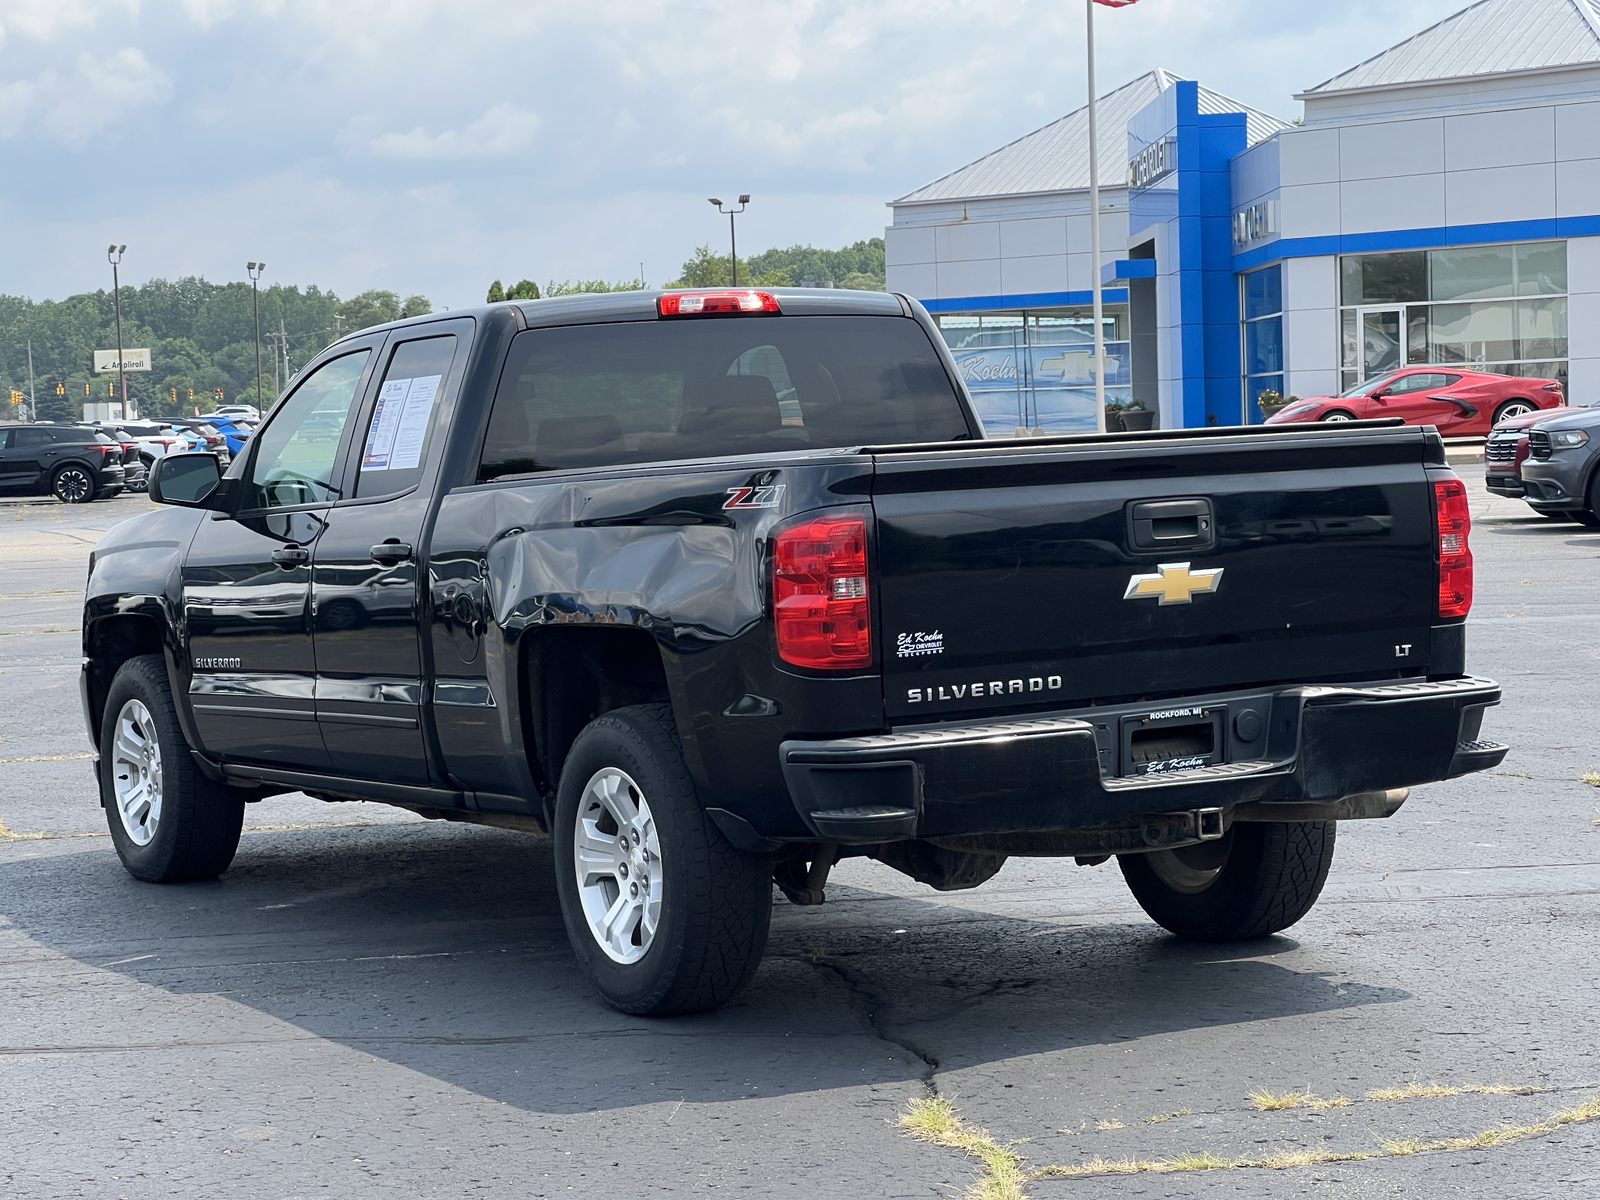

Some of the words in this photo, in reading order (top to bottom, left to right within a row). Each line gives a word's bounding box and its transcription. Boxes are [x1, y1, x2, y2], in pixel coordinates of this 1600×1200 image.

[963, 354, 1022, 382] Koehn
[721, 484, 786, 510] Z71
[897, 632, 913, 645] Ed
[914, 629, 943, 643] Koehn
[915, 641, 943, 649] CHEVROLET
[1395, 644, 1412, 657] LT
[195, 657, 241, 668] SILVERADO
[907, 675, 1062, 703] SILVERADO
[1149, 709, 1191, 720] ROCKFORD,
[1192, 707, 1201, 715] MI
[1146, 760, 1165, 772] Ed
[1168, 756, 1204, 768] Koehn
